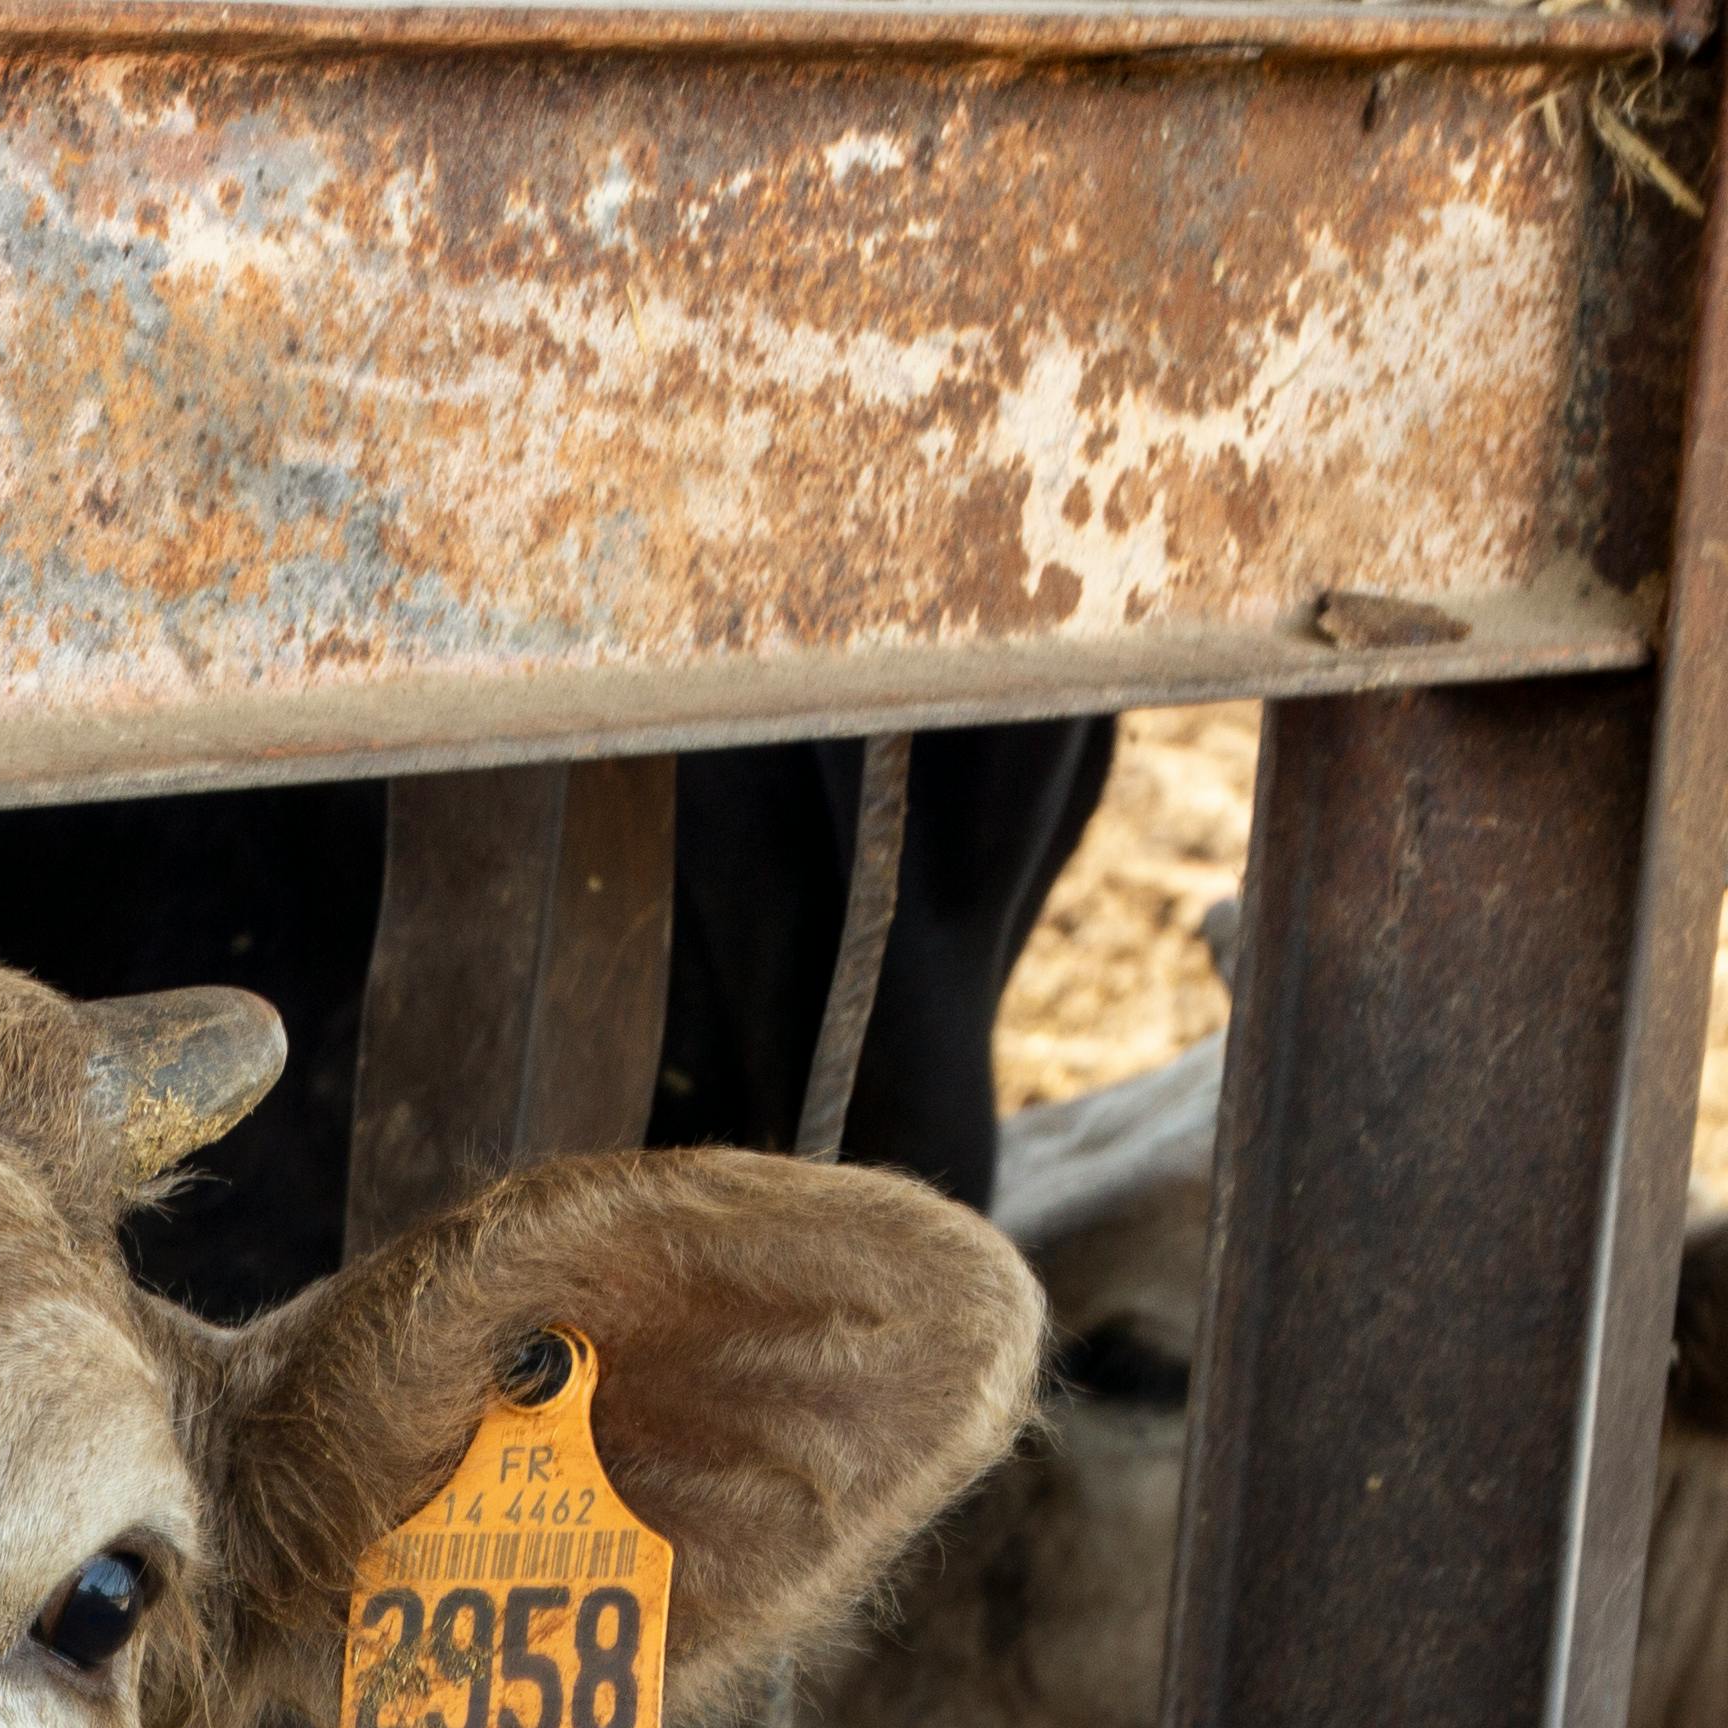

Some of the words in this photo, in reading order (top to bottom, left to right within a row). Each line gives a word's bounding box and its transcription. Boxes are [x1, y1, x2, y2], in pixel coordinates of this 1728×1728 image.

[499, 1445, 554, 1484] FR
[444, 1490, 485, 1526] 14
[505, 1487, 597, 1526] 4462
